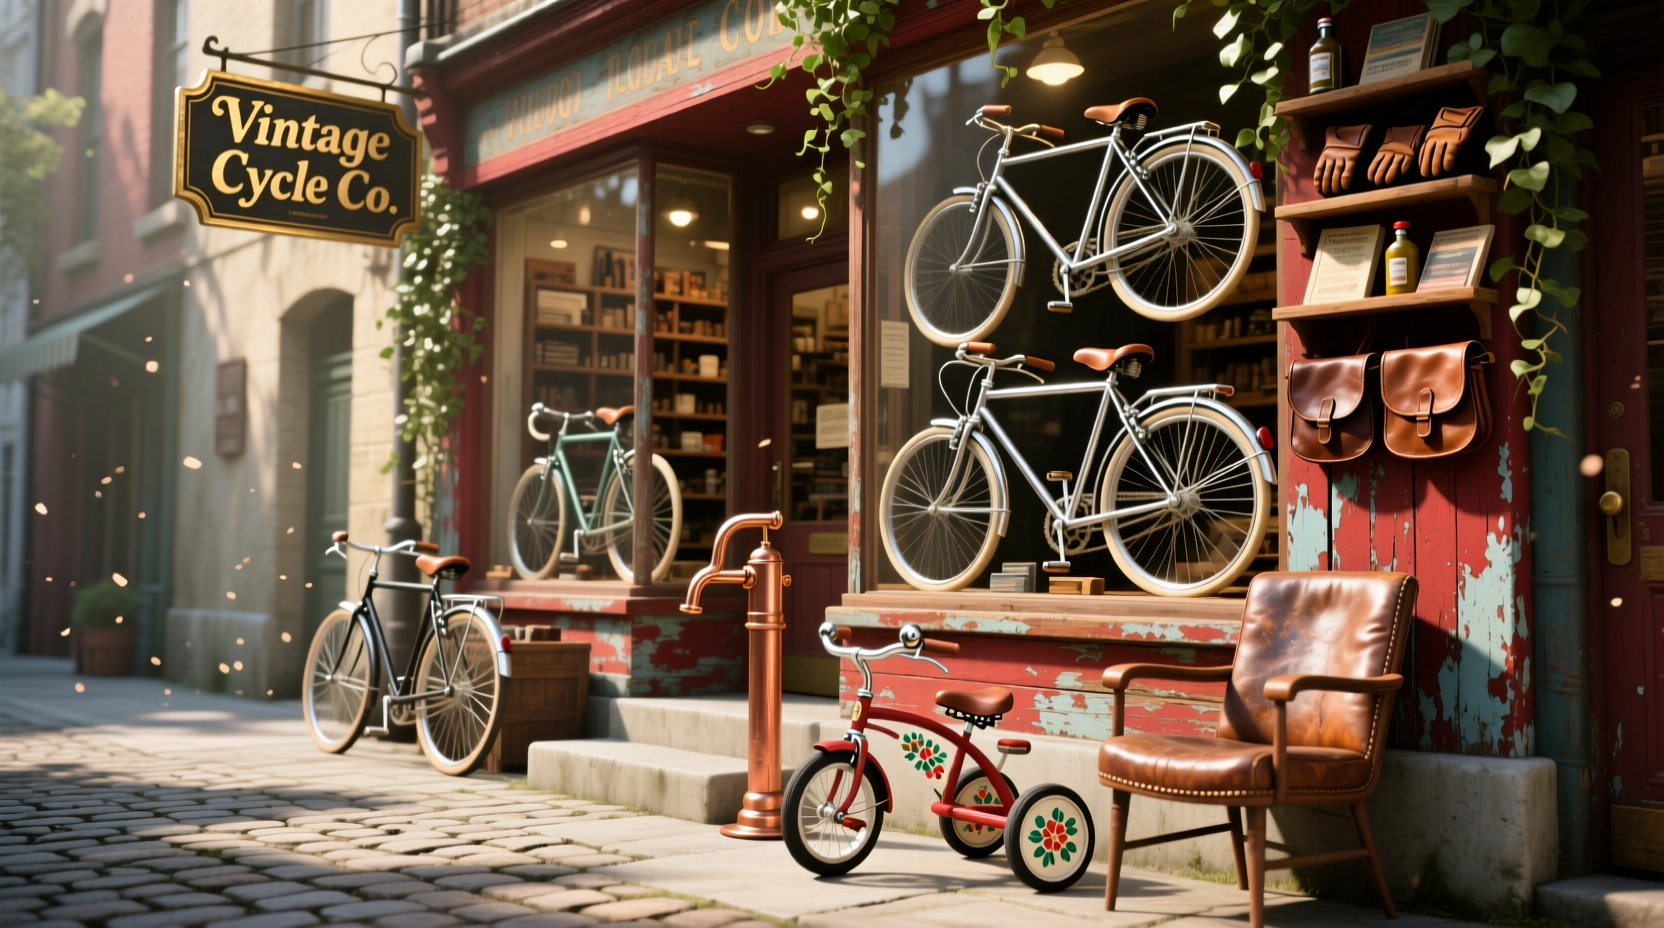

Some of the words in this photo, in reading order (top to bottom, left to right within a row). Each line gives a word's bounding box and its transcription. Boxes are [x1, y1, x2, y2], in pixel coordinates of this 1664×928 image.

[212, 95, 391, 168] Vintage
[211, 149, 329, 208] Cycle
[337, 169, 398, 215] Co.
